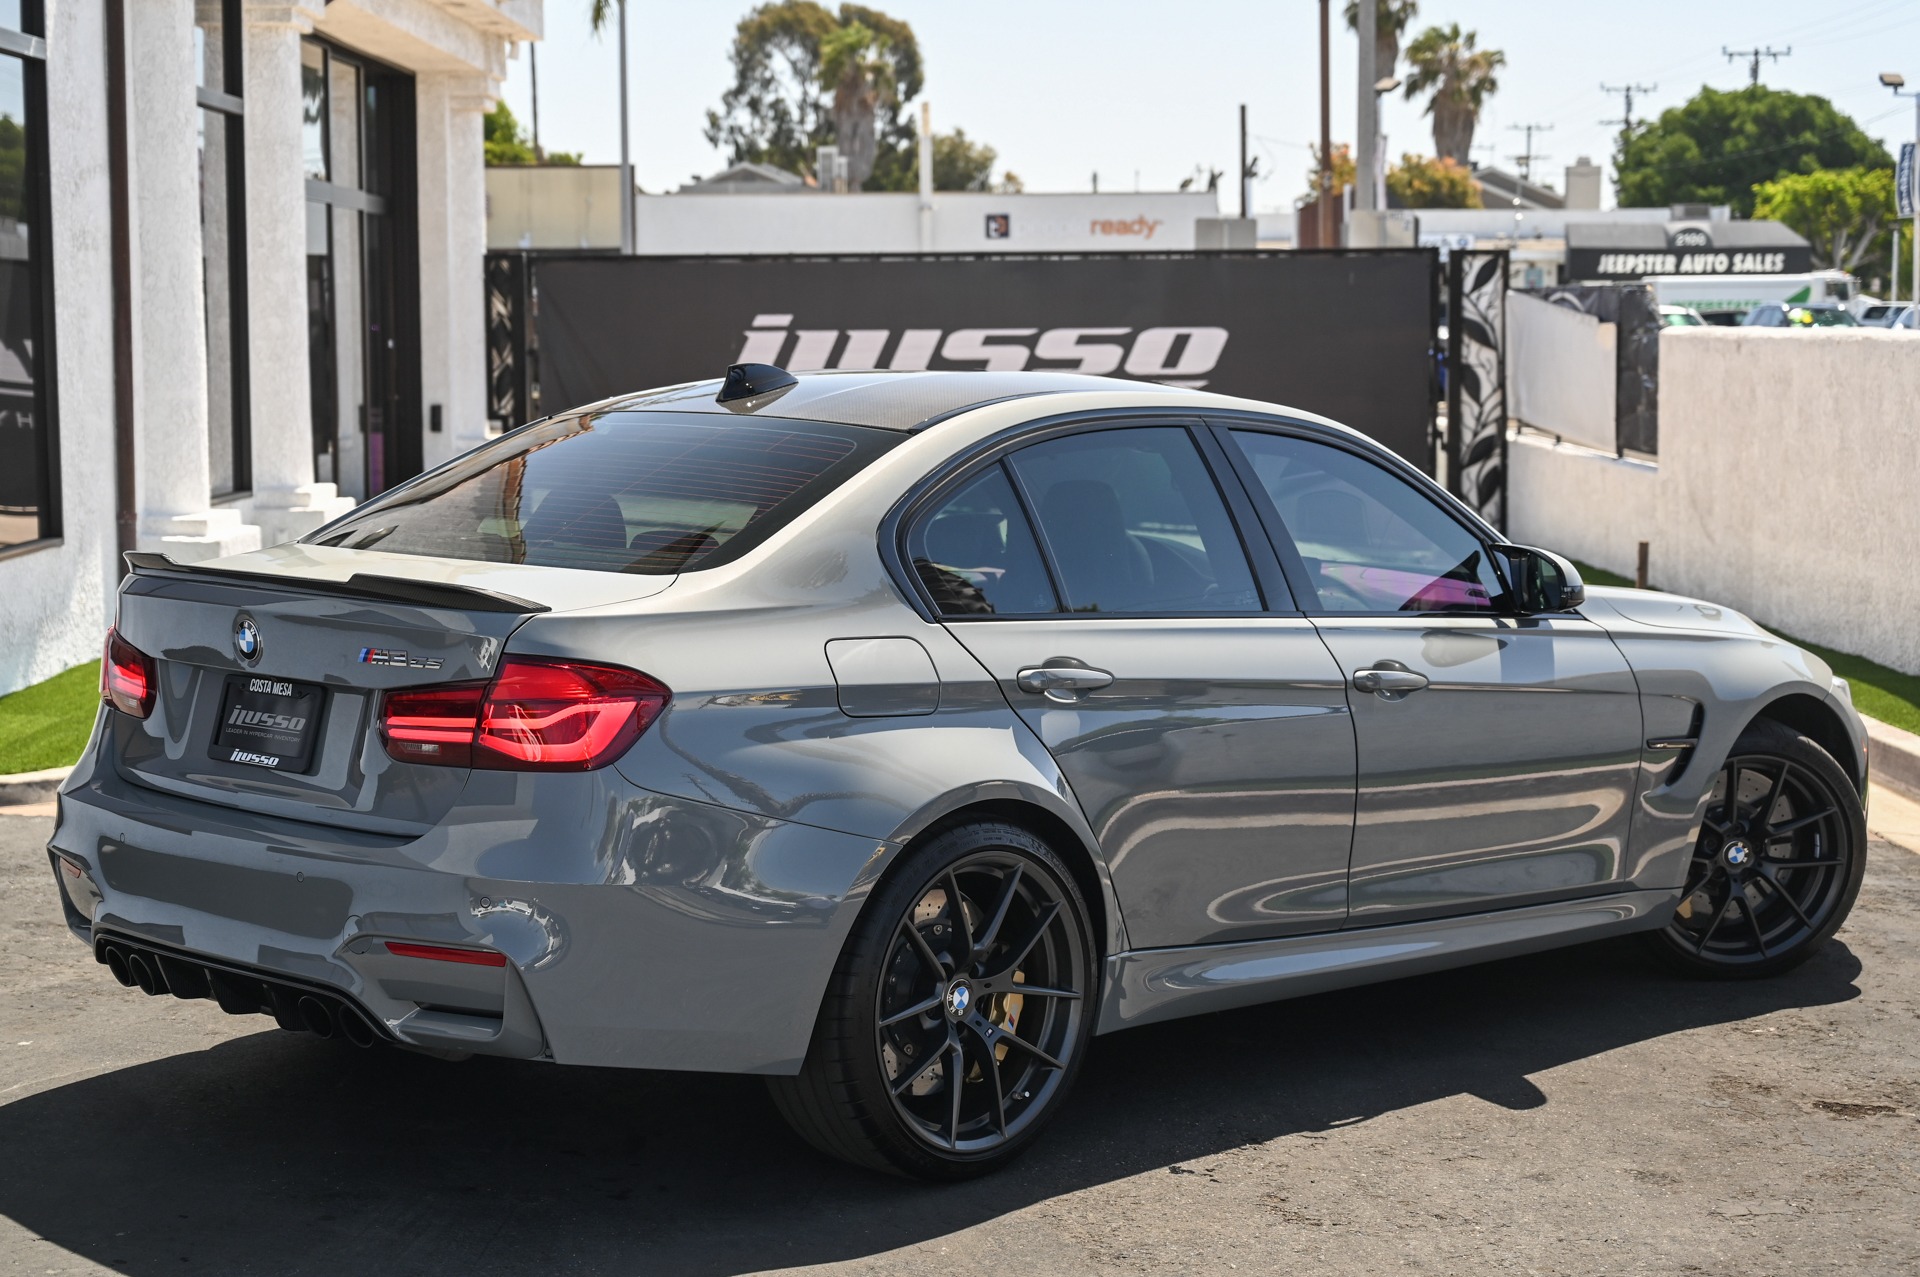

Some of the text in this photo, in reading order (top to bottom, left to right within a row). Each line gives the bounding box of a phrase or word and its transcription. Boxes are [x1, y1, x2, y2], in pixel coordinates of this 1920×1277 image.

[1091, 214, 1159, 239] ready
[1598, 253, 1785, 273] JEEPSTER AUTO SALES
[249, 679, 293, 696] COSTA MESA
[225, 727, 243, 735] LEADER
